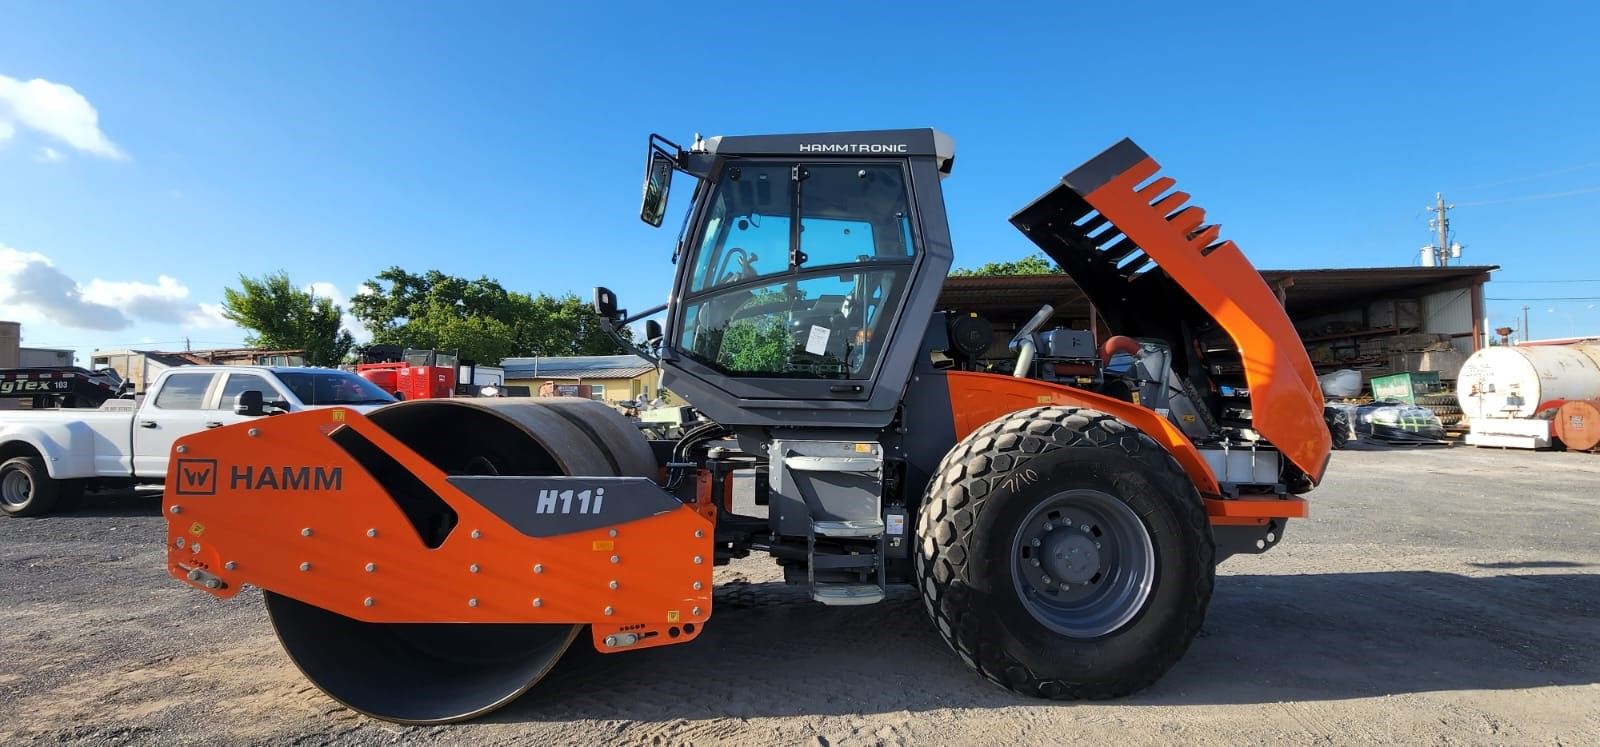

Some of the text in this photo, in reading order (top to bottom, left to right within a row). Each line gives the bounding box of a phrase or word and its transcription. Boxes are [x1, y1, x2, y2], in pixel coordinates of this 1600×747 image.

[799, 143, 908, 153] HAMMTRONIC
[230, 465, 342, 491] HAMM
[1002, 469, 1038, 493] 7/10
[536, 487, 604, 514] H11i
